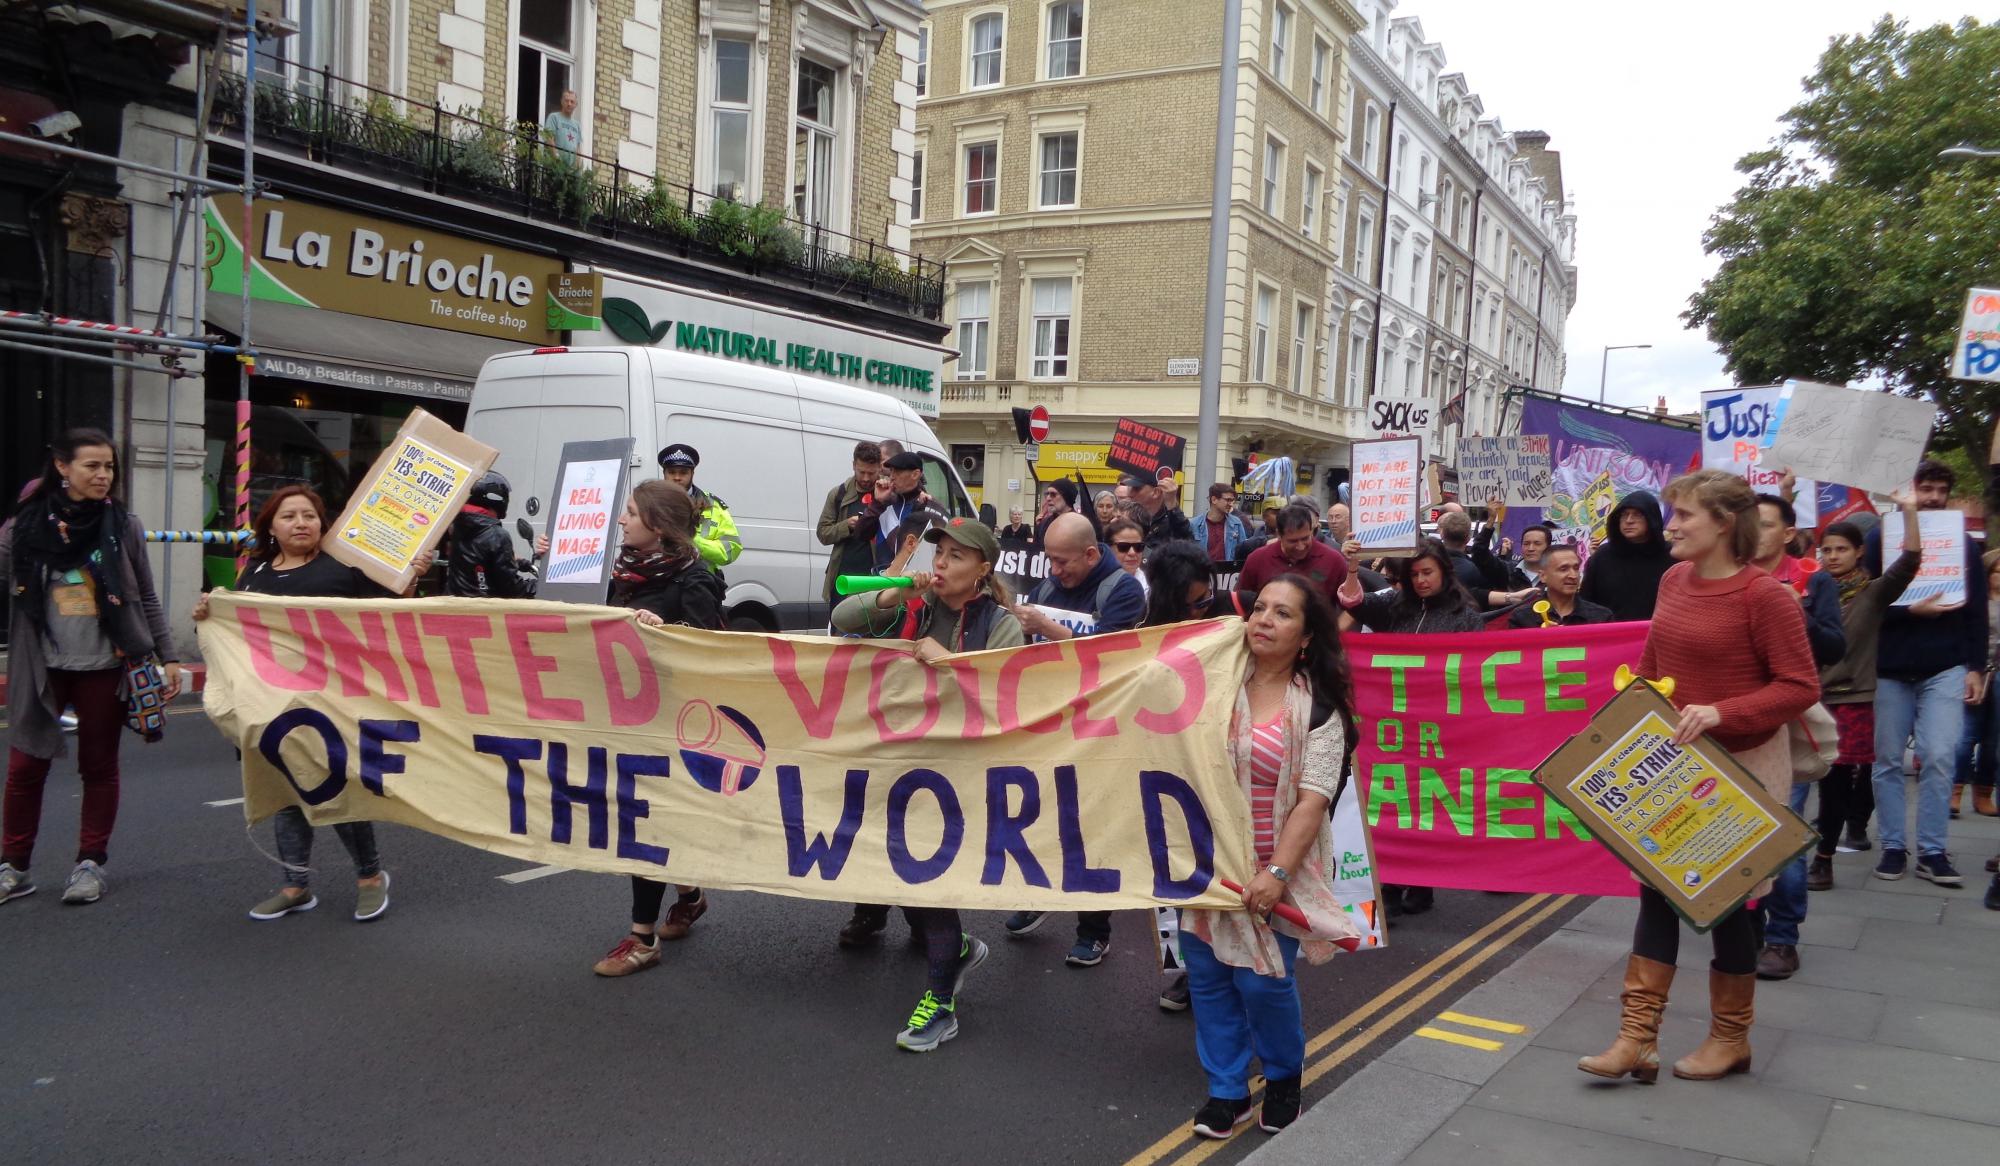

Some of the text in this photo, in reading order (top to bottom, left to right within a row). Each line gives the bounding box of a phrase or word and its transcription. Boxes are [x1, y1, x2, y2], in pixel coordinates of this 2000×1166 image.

[264, 210, 534, 306] La Brioche
[559, 286, 593, 298] Brioche
[560, 275, 571, 286] La
[430, 299, 527, 332] The coffee shop
[676, 321, 935, 393] NATURAL HEALTH CENTRE
[264, 359, 283, 373] All
[286, 362, 312, 379] Day
[315, 366, 375, 385] Breakfast
[385, 376, 424, 392] Pastas
[1372, 401, 1413, 432] SACK
[1115, 432, 1160, 456] GET RID OF
[1119, 419, 1176, 447] WE'VE GOT TO
[402, 444, 424, 464] 100%
[1110, 445, 1130, 461] THE
[1555, 440, 1671, 488] UNISON
[393, 457, 413, 476] YES
[417, 471, 453, 497] STRIKE
[1506, 466, 1529, 489] paid
[568, 488, 601, 506] REAL
[1392, 494, 1408, 505] WE
[558, 512, 606, 530] LIVING
[557, 538, 600, 555] WAGE
[235, 606, 1226, 743] UNITED VOICES
[1371, 647, 1587, 714] TICE
[1352, 716, 1444, 759] OR
[1643, 735, 1661, 750] vote
[1580, 733, 1649, 797] 100% of cleaners
[1595, 739, 1682, 813] YES to STRIKE
[259, 707, 1214, 899] OF THE WORLD
[1613, 814, 1623, 823] for
[1622, 806, 1632, 815] the
[1631, 789, 1653, 807] London
[1651, 775, 1670, 790] Living
[1667, 760, 1685, 775] Wage
[1340, 866, 1372, 880] hour
